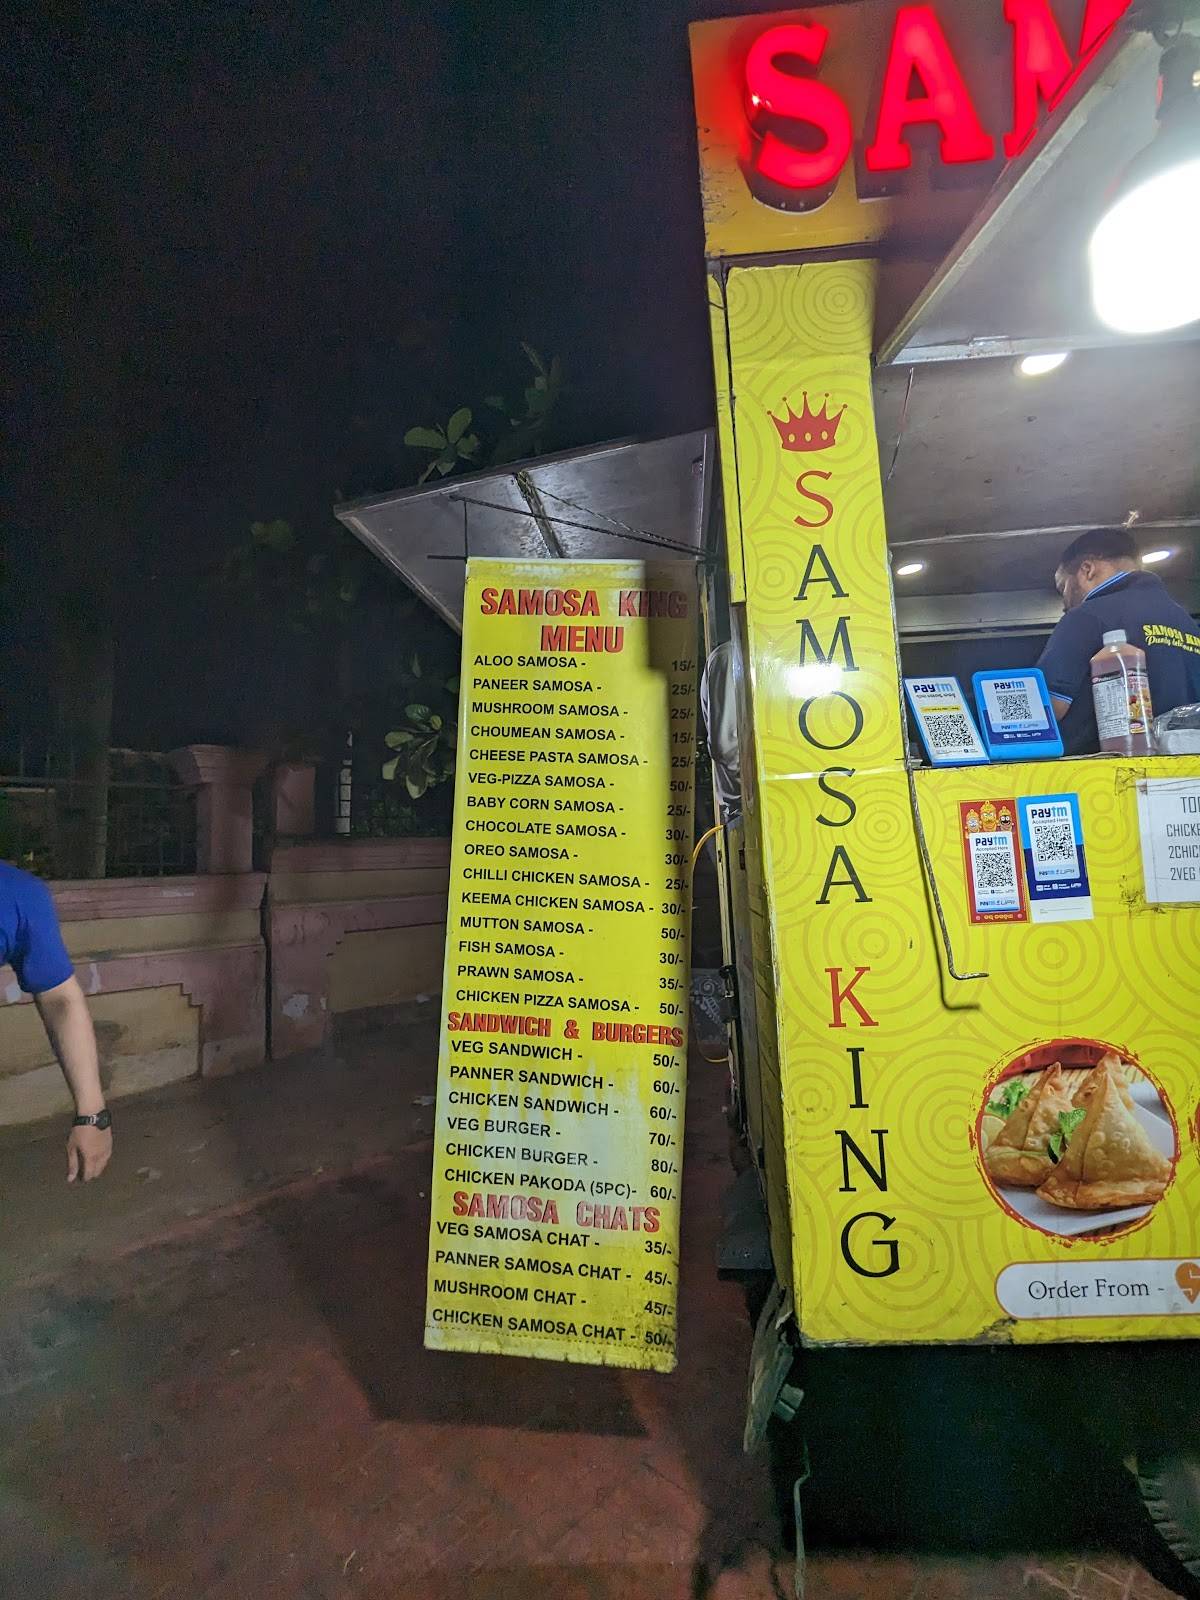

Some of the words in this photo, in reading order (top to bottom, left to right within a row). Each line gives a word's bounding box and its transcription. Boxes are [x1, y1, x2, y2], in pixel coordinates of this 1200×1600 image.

[480, 588, 600, 617] SAMOSA
[618, 590, 690, 620] KING
[540, 625, 624, 653] MENU
[473, 654, 514, 667] ALOO
[517, 655, 578, 668] SAMOSA
[672, 660, 696, 672] 15/-
[473, 678, 529, 691] PANEER
[532, 679, 593, 692] SAMOSA
[672, 684, 696, 696] 25/-
[792, 468, 874, 904] SAMOSA
[472, 701, 554, 715] MUSHROOM
[558, 704, 620, 717] SAMOSA
[671, 708, 694, 720] 25/-
[470, 725, 551, 739] CHOUMEAN
[554, 728, 616, 741] SAMOSA
[672, 732, 694, 744] 15/-
[469, 749, 526, 762] CHEESE
[529, 750, 574, 764] PASTA
[577, 752, 640, 766] SAMOSA
[672, 756, 694, 768] 25/-
[468, 772, 541, 786] VEG-PIZZA
[544, 775, 606, 788] SAMOSA
[670, 780, 692, 792] 50/-
[467, 796, 506, 808] BABY
[509, 798, 550, 810] CORN
[553, 799, 616, 814] SAMOSA
[666, 804, 691, 816] 25/-
[465, 820, 552, 835] CHOCOLATE
[555, 824, 618, 838] SAMOSA
[665, 829, 689, 841] 30/-
[464, 844, 505, 857] OREO
[508, 845, 570, 860] SAMOSA
[664, 854, 688, 866] 30/-
[1168, 844, 1200, 859] 2CHIC
[463, 868, 508, 881] CHILLI
[511, 870, 574, 885] CHICKEN
[578, 874, 641, 888] SAMOSA
[665, 878, 689, 890] 25/-
[1170, 866, 1196, 881] 2VEG
[462, 892, 512, 906] KEEMA
[515, 894, 578, 910] CHICKEN
[582, 898, 645, 913] SAMOSA
[661, 902, 686, 915] 30/-
[460, 916, 519, 930] MUTTON
[523, 919, 585, 934] SAMOSA
[660, 928, 686, 940] 50/-
[458, 940, 490, 953] FISH
[494, 942, 556, 958] SAMOSA
[659, 952, 684, 965] 30/-
[457, 965, 510, 979] PRAWN
[513, 968, 575, 984] SAMOSA
[659, 977, 684, 990] 35/-
[456, 989, 520, 1004] CHICKEN
[524, 993, 564, 1008] PIZZA
[568, 996, 631, 1012] SAMOSA
[659, 1002, 684, 1016] 50/-
[448, 1011, 552, 1038] SANDWICH
[564, 1020, 580, 1040] &
[592, 1022, 684, 1048] BURGERS
[451, 1040, 484, 1054] VEG
[488, 1042, 572, 1061] SANDWICH
[652, 1053, 680, 1068] 50/-
[450, 1065, 514, 1082] PANNER
[518, 1070, 603, 1090] SANDWICH
[653, 1080, 680, 1095] 60/-
[448, 1091, 519, 1108] CHICKEN
[523, 1096, 608, 1116] SANDWICH
[649, 1106, 677, 1121] 60/-
[447, 1116, 480, 1131] VEG
[484, 1119, 551, 1138] BURGER
[648, 1132, 676, 1147] 70/-
[824, 966, 902, 1280] KING
[446, 1142, 516, 1160] CHICKEN
[521, 1147, 588, 1166] BURGER
[651, 1158, 678, 1174] 80/-
[444, 1168, 515, 1186] CHICKEN
[520, 1173, 586, 1192] PAKODA
[650, 1185, 676, 1201] 60/-
[452, 1190, 560, 1224] SAMOSA
[576, 1200, 660, 1234] CHATS
[436, 1221, 469, 1236] VEG
[473, 1225, 543, 1244] SAMOSA
[546, 1232, 590, 1248] CHAT
[644, 1240, 672, 1256] 35/-
[435, 1250, 500, 1269] PANNER
[504, 1257, 574, 1276] SAMOSA
[578, 1263, 622, 1281] CHAT
[644, 1270, 672, 1286] 45/-
[433, 1279, 528, 1301] MUSHROOM
[533, 1288, 577, 1306] CHAT
[644, 1300, 672, 1316] 45/-
[1028, 1280, 1089, 1300] Order
[1094, 1278, 1150, 1298] From
[432, 1308, 503, 1329] CHICKEN
[507, 1317, 578, 1337] SAMOSA
[582, 1323, 626, 1341] CHAT
